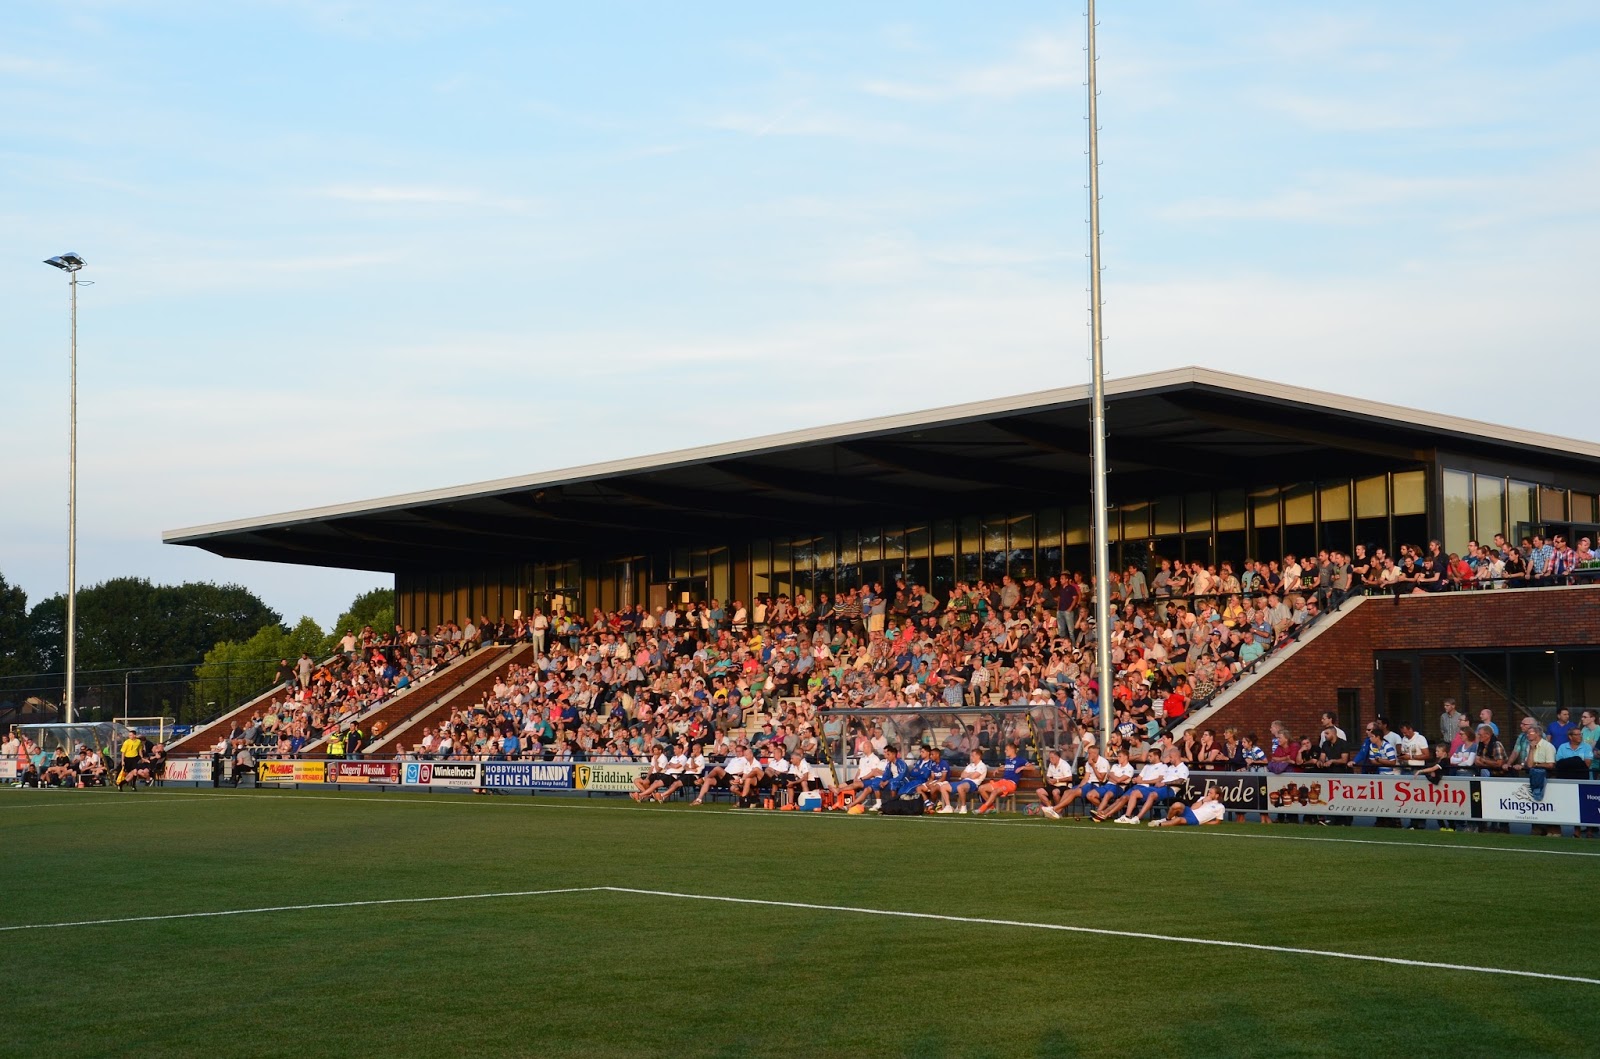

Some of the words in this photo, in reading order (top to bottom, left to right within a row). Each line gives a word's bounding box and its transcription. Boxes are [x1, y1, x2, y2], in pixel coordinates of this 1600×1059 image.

[340, 764, 362, 776] Slagerij
[363, 764, 386, 775] Wassink
[434, 766, 475, 777] Winkelhorst
[485, 765, 530, 773] HOBBYHUIS
[531, 766, 570, 781] HANDY
[485, 774, 530, 786] HEINEN
[592, 771, 634, 784] Hiddink
[1183, 777, 1254, 803] k-Ende
[1327, 779, 1384, 802] Fazil
[1499, 798, 1554, 814] Kingspan
